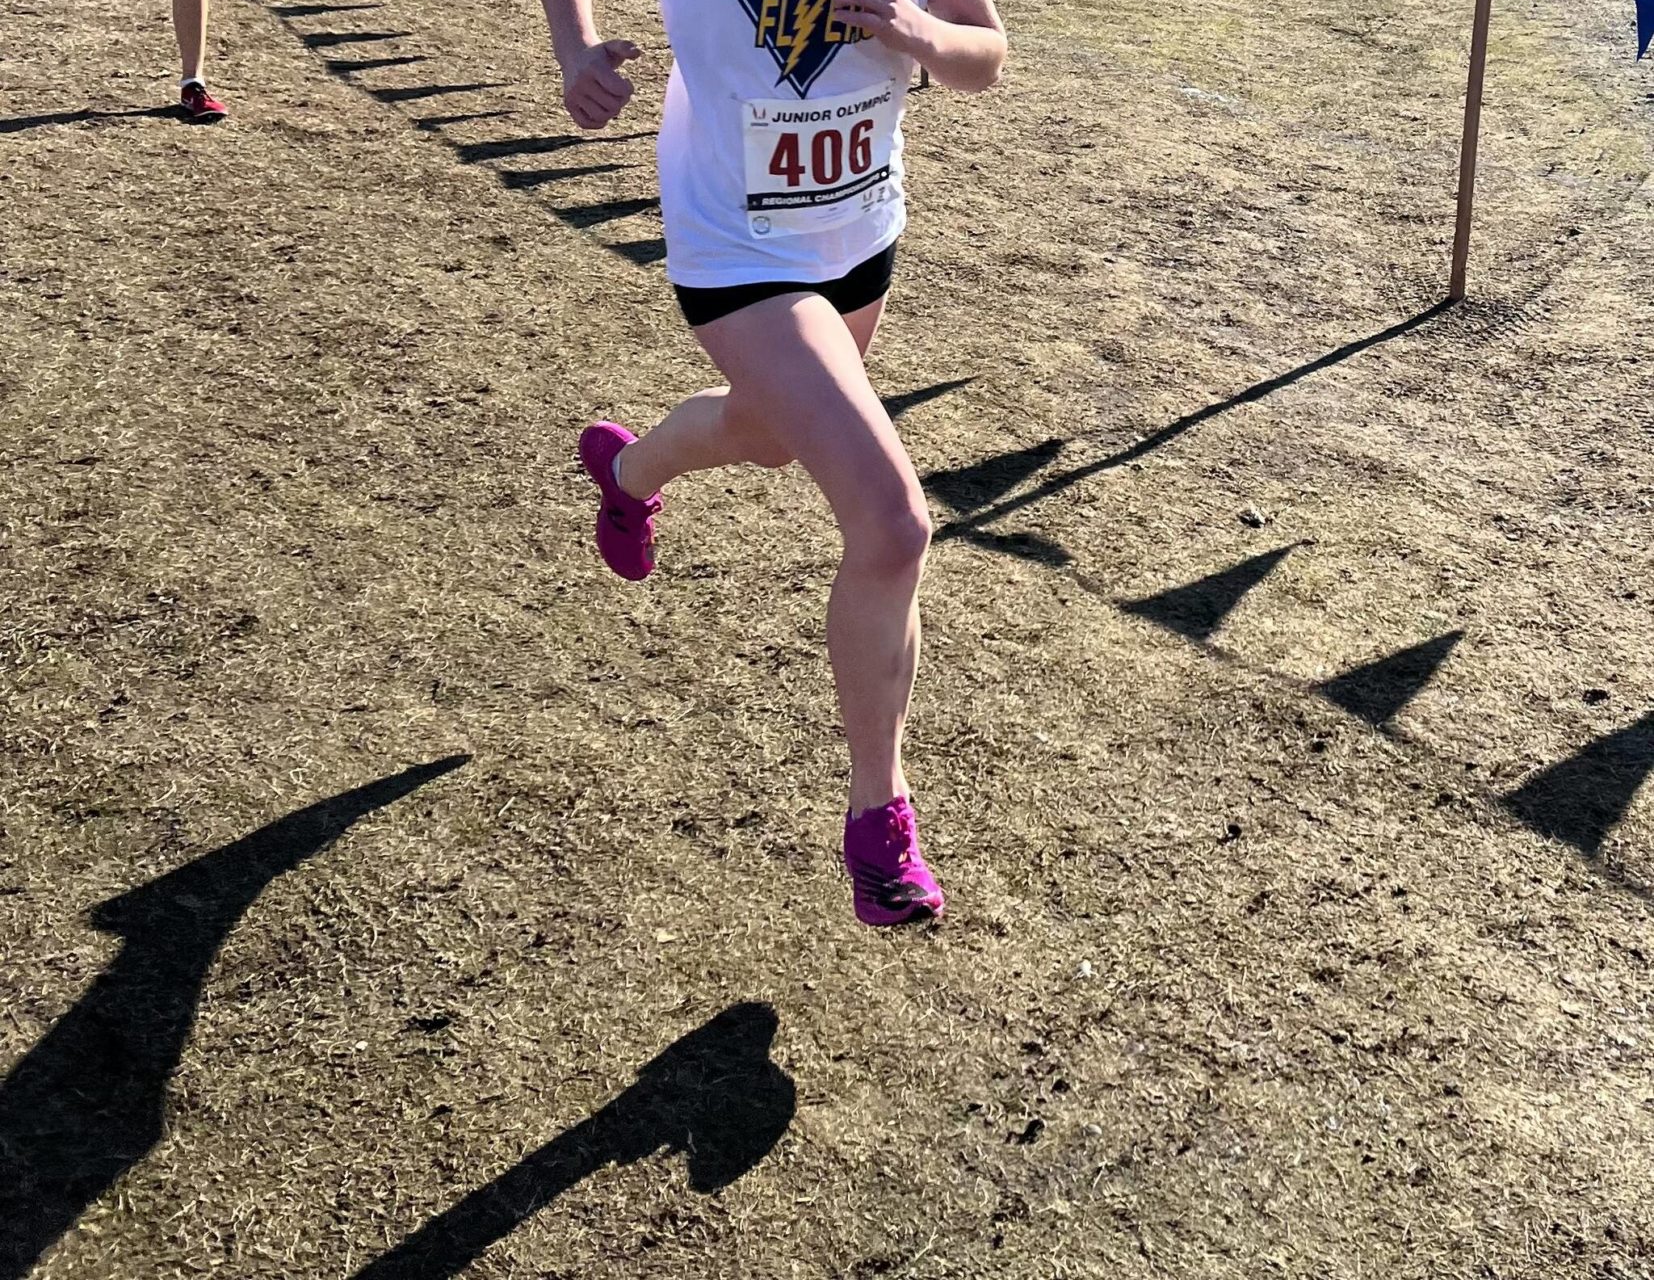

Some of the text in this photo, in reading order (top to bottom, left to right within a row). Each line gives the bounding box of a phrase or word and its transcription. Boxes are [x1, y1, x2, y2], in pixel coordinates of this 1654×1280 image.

[771, 91, 892, 123] JUNIOR OLYMPIC
[769, 119, 874, 187] 406
[761, 195, 813, 206] REGIONAL
